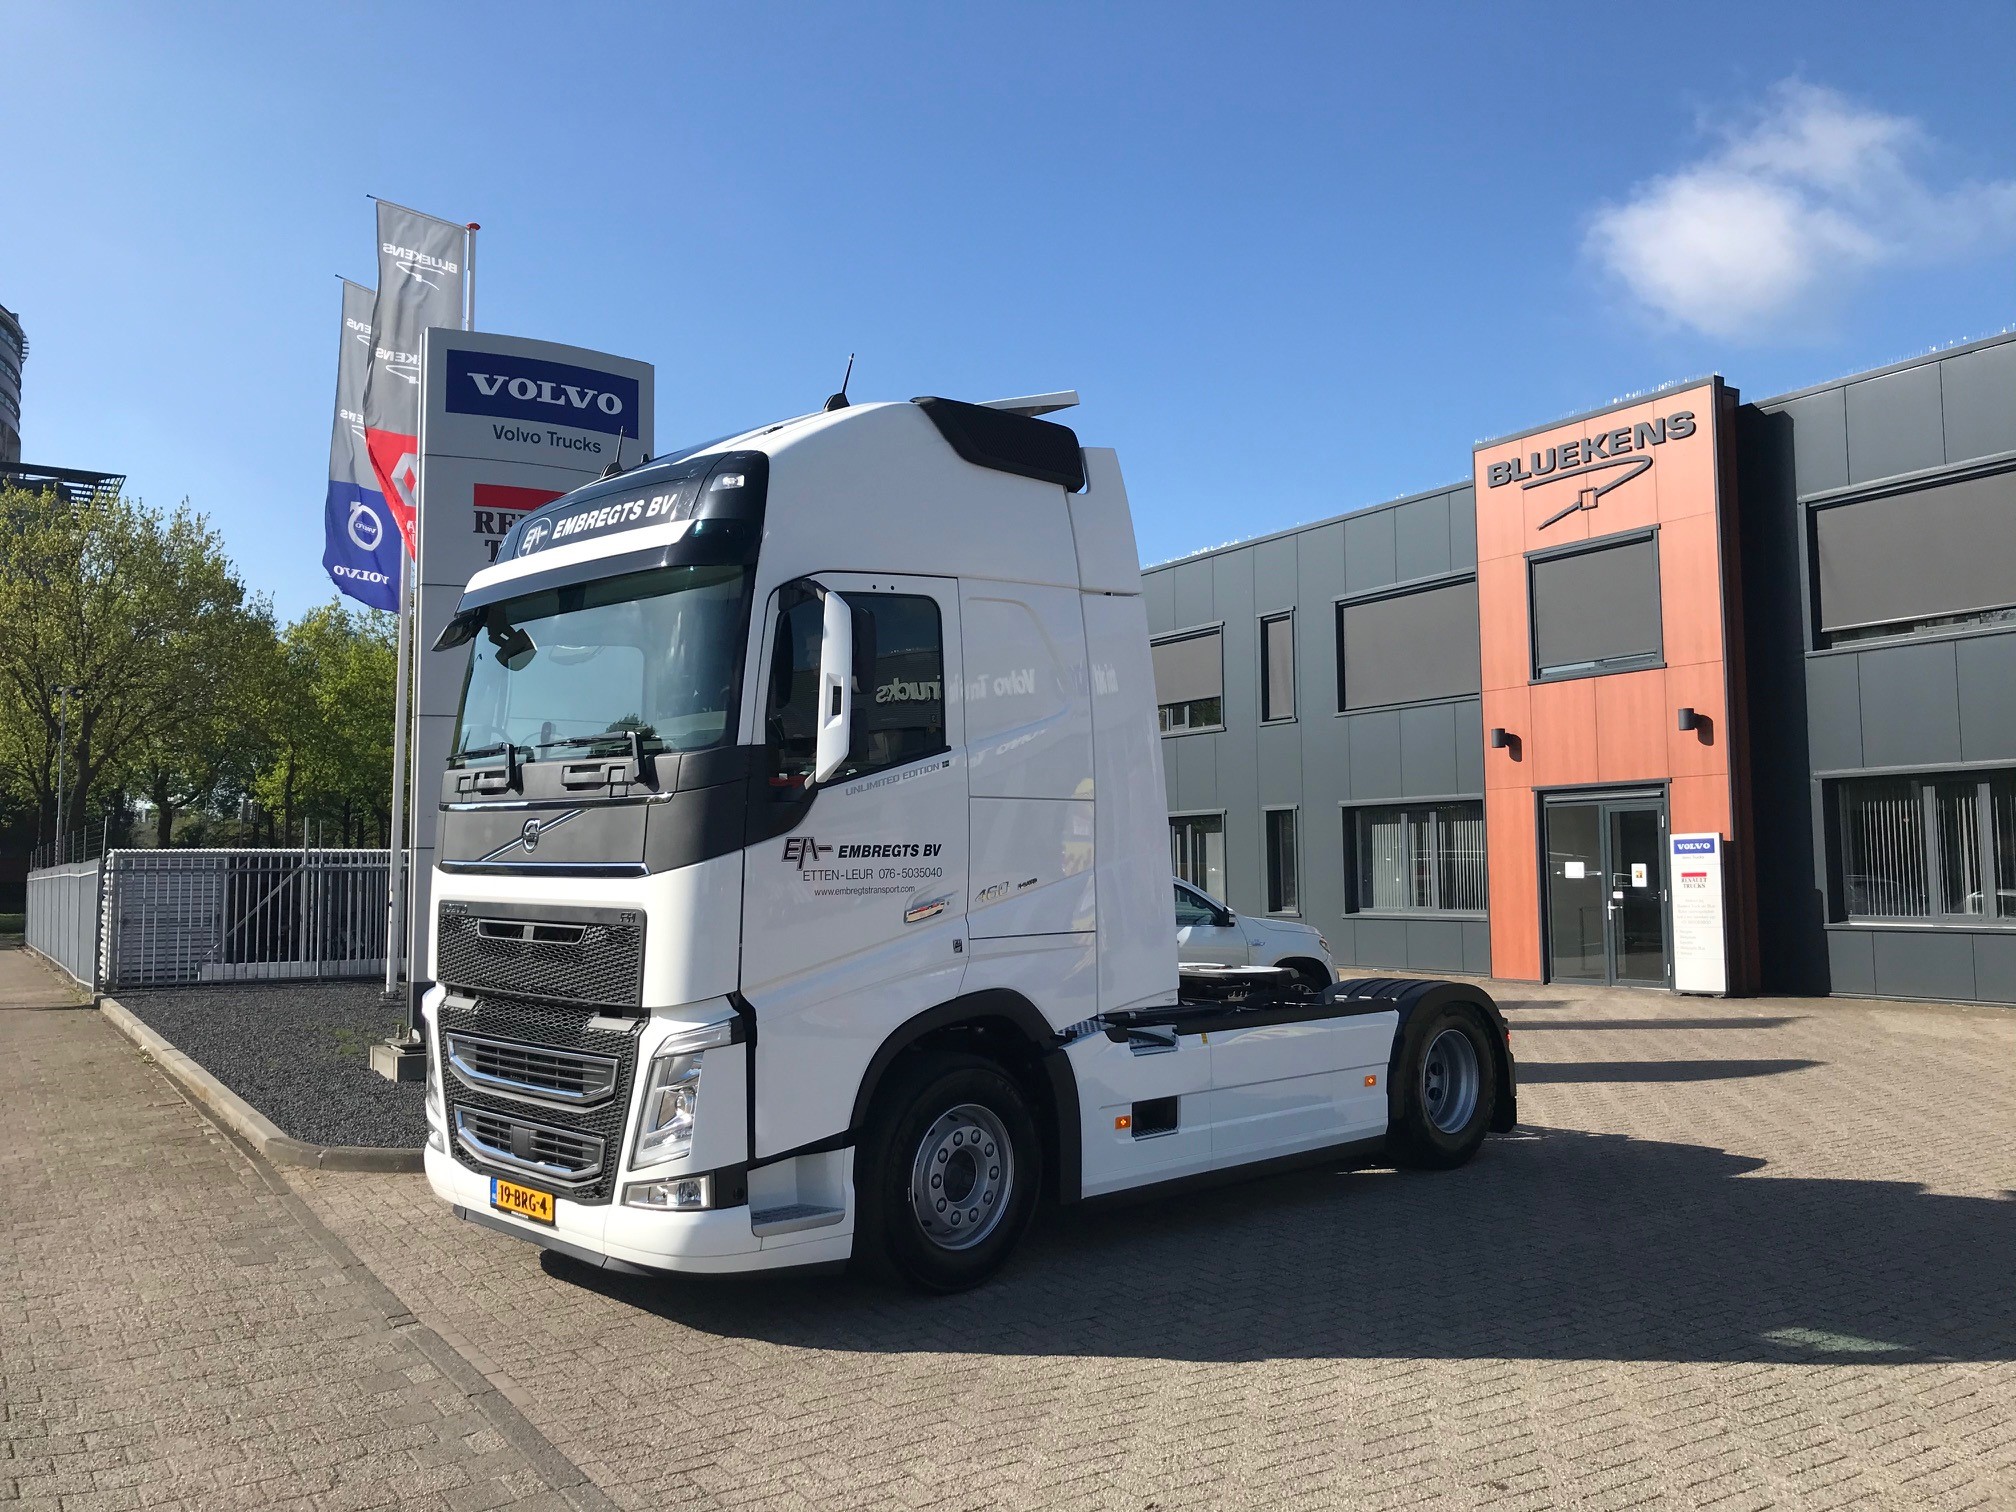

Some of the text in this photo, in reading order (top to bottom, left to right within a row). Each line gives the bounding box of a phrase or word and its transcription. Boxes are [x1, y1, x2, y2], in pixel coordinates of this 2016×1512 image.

[467, 372, 623, 415] VOLVO
[492, 424, 602, 453] Volvo Trucks
[1487, 410, 1697, 489] BLUEKENS
[552, 499, 645, 540] EMBREGTS
[645, 493, 678, 518] BV
[845, 762, 940, 796] UNLIMITED EDITION
[838, 844, 920, 859] EMBREGTS
[923, 843, 942, 857] BV
[1677, 842, 1711, 850] VOLVO
[802, 867, 943, 882] ETTEN-LEUR 076-5035040
[814, 885, 916, 897] www.embregtstransport.com
[500, 1184, 548, 1215] 19-BRG-4
